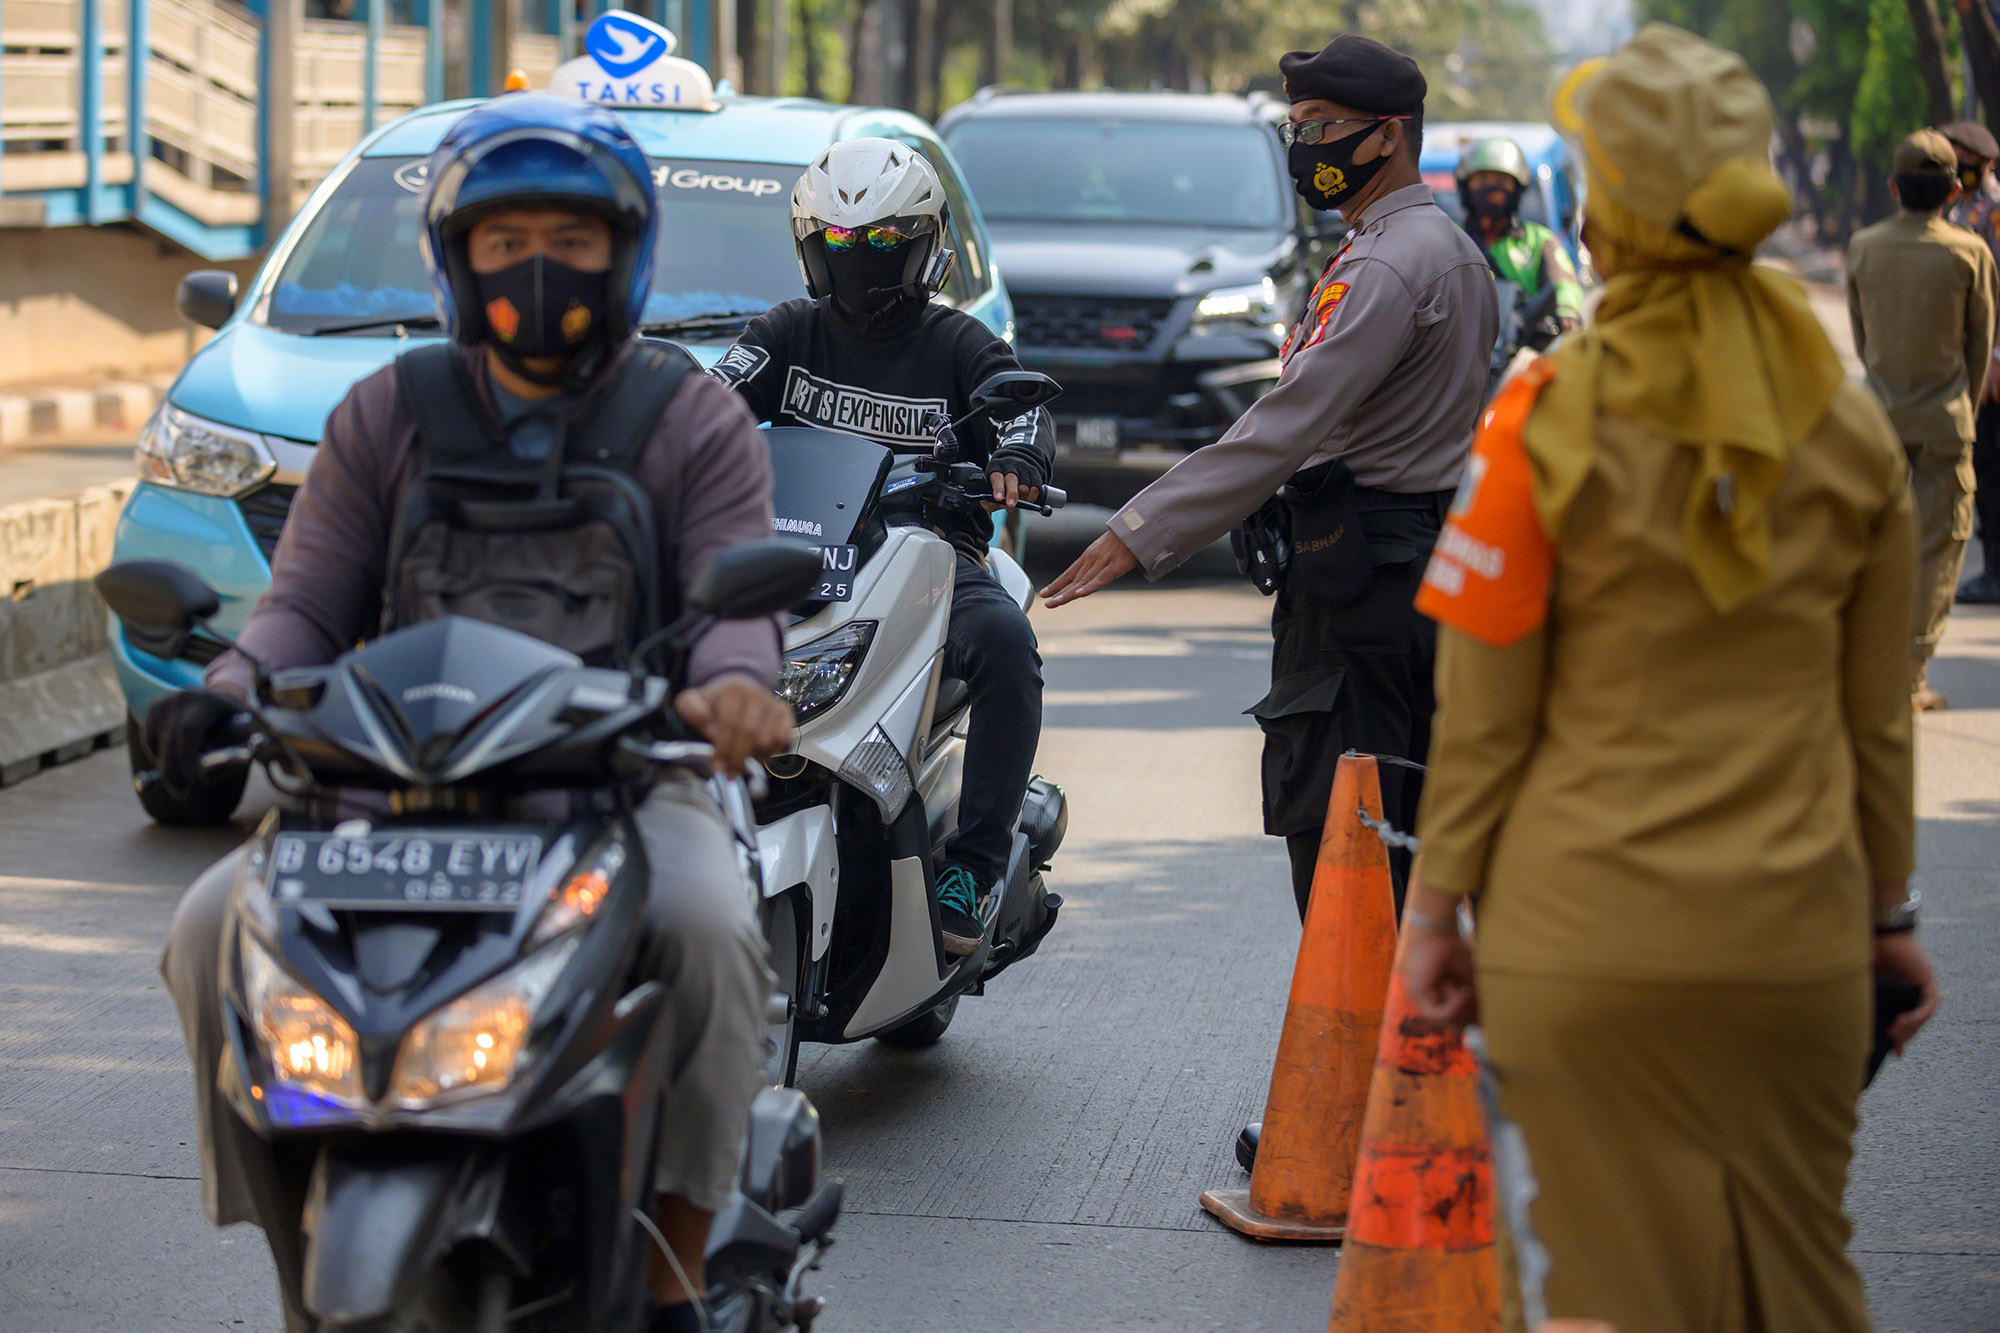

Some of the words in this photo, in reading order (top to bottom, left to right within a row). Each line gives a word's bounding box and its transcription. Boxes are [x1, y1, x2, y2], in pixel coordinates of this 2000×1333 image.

[576, 81, 680, 103] TAKSI
[671, 168, 782, 197] Group
[789, 376, 819, 414] ART
[277, 838, 307, 874] B
[317, 838, 434, 876] 6548
[447, 839, 532, 876] EYV
